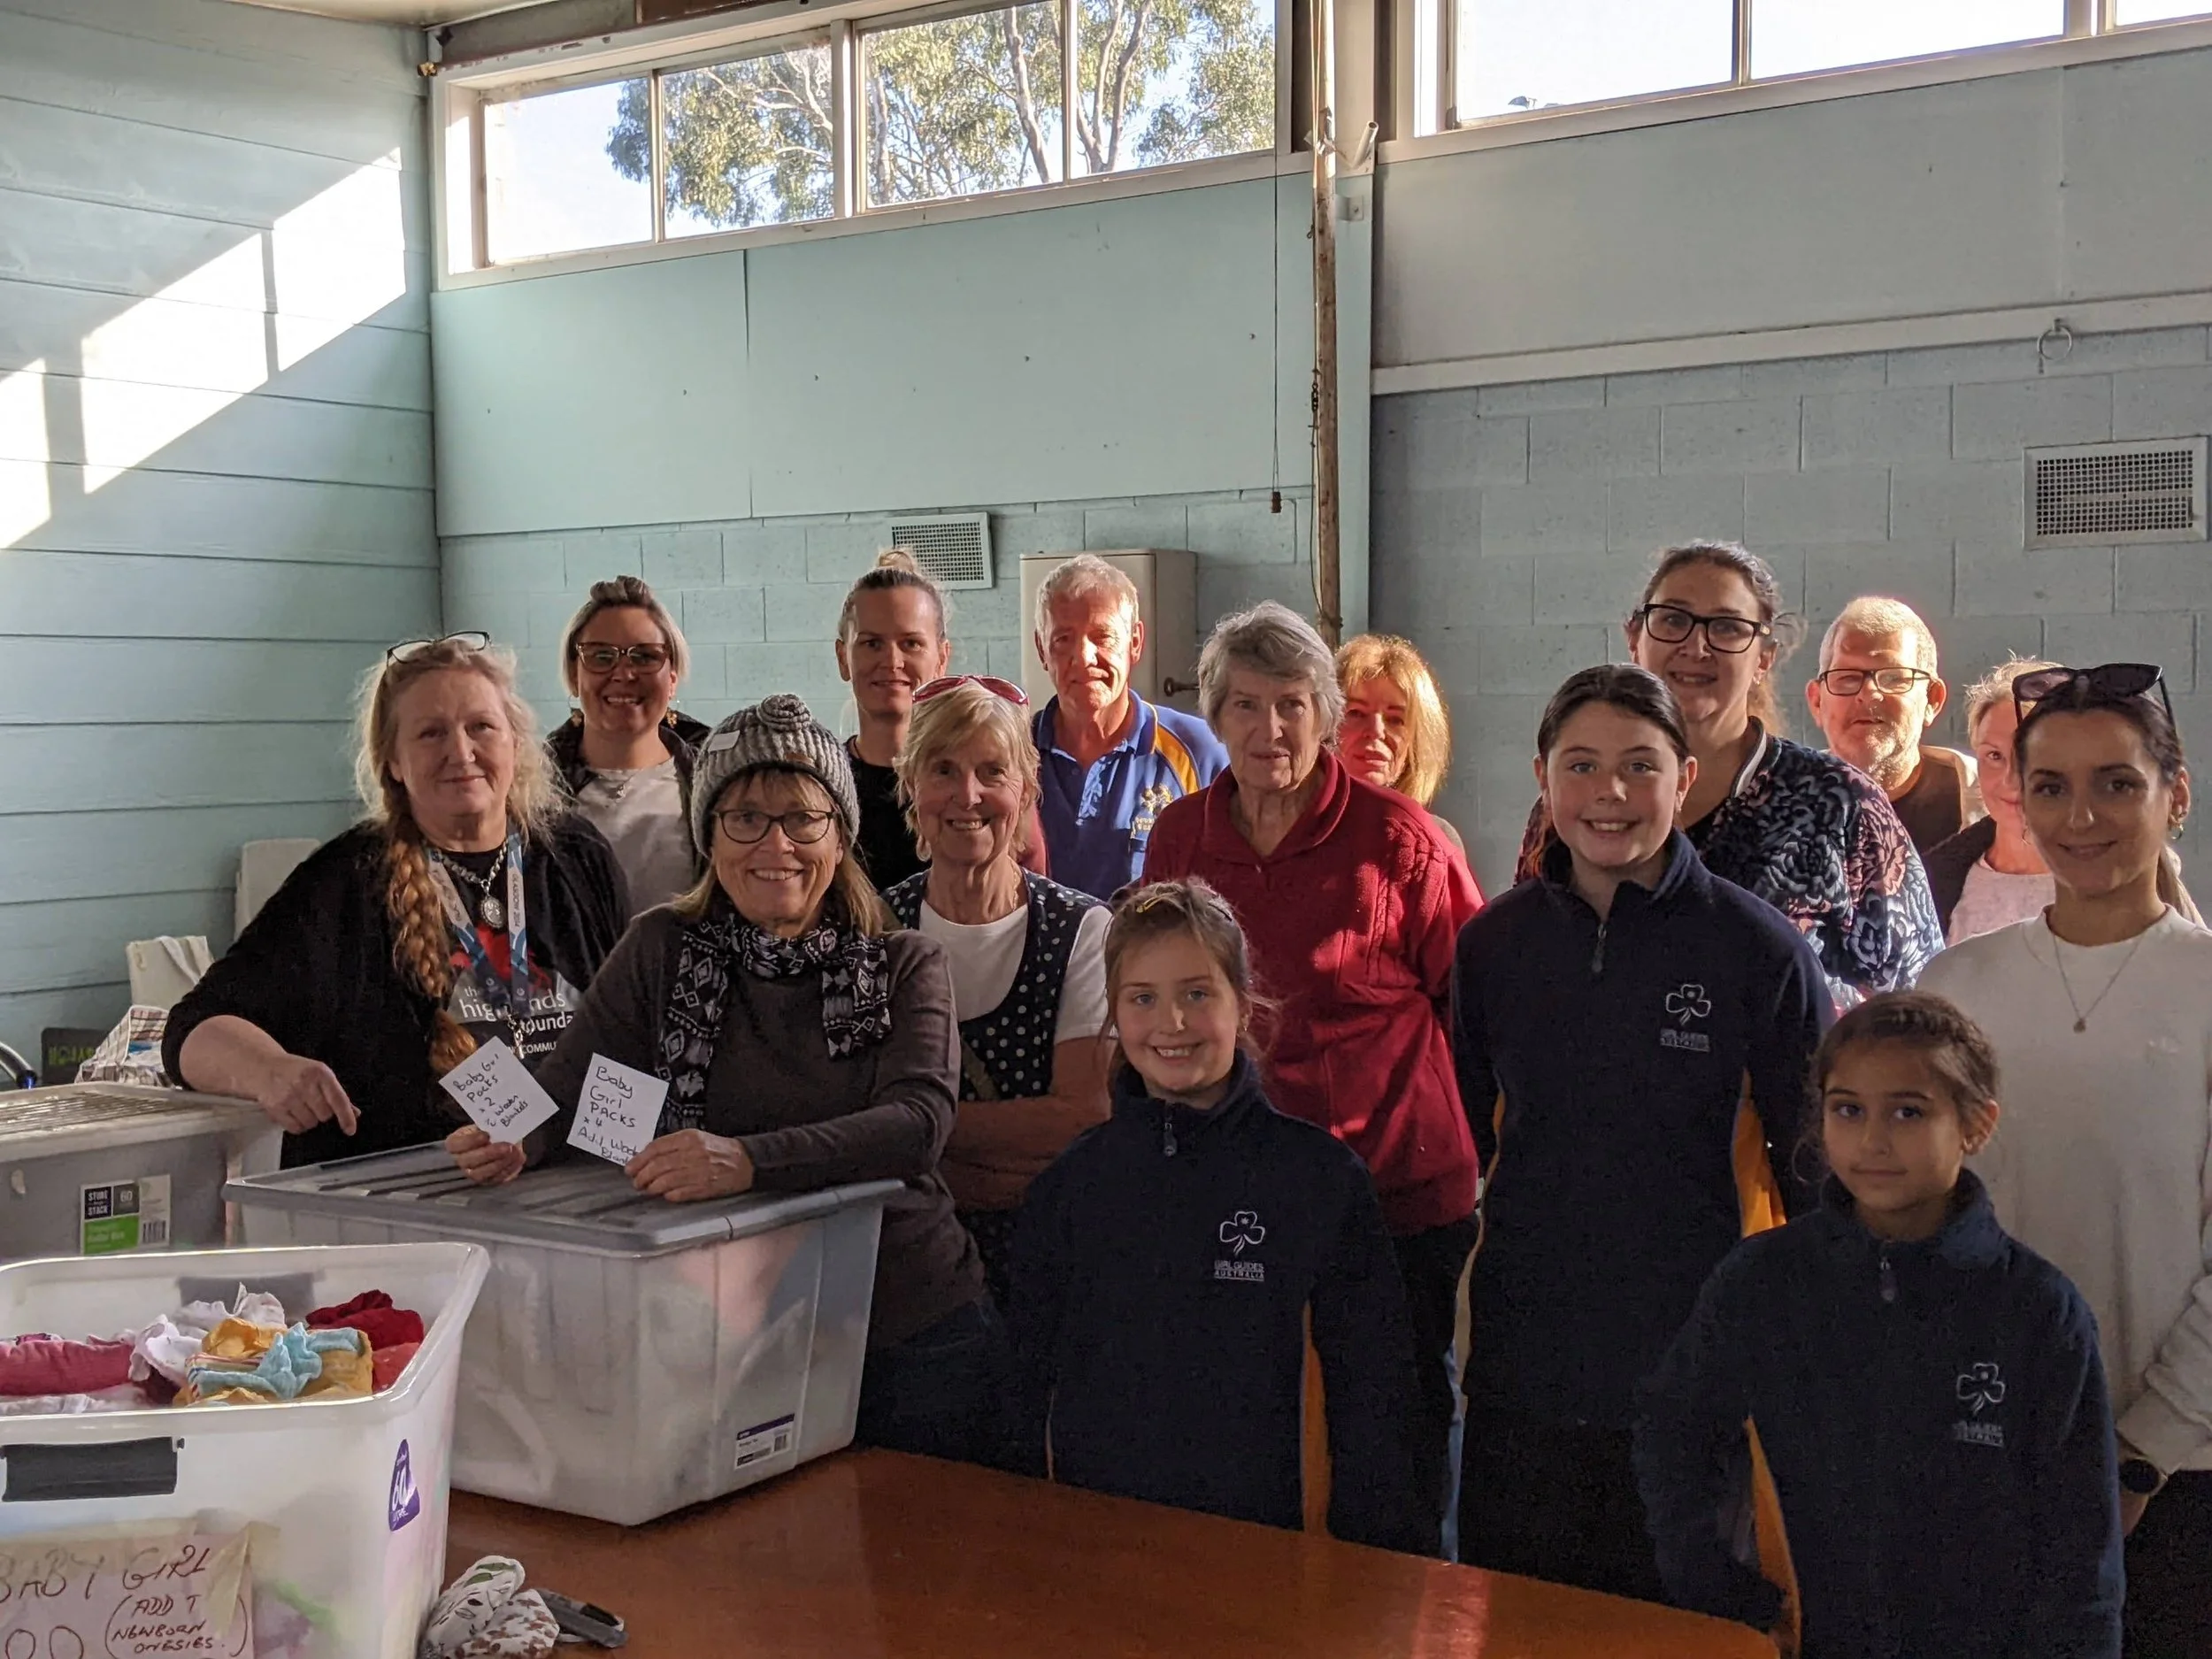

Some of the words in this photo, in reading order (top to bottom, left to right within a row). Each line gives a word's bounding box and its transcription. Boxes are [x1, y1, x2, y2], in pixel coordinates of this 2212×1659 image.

[464, 985, 479, 997] th
[453, 1073, 485, 1092] Baby
[595, 1066, 634, 1099] Baby
[484, 1096, 495, 1107] 2
[589, 1085, 622, 1109] Girl
[590, 1101, 636, 1128] PACKS
[595, 1118, 603, 1126] 4
[122, 1545, 210, 1590] GIRL
